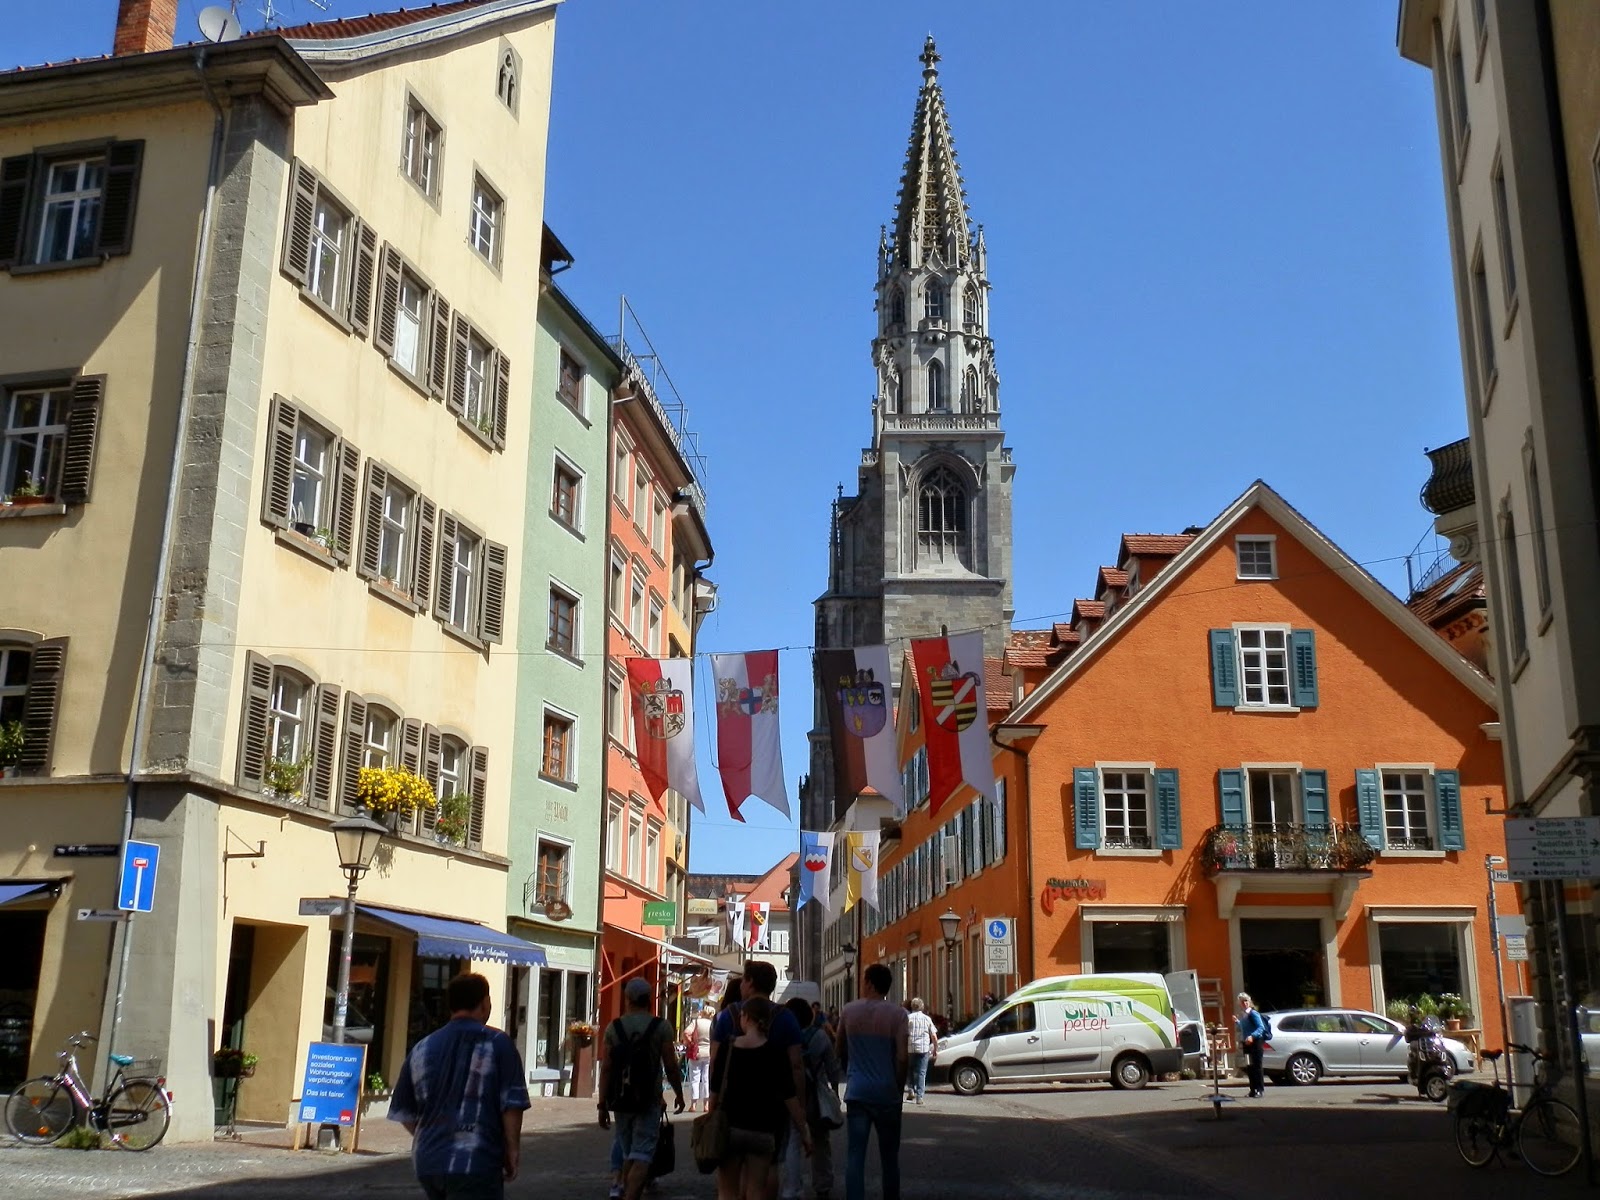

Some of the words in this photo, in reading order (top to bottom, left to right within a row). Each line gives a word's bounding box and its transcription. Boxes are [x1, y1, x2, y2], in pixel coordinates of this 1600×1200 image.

[1063, 1008, 1111, 1041] peter
[311, 1053, 344, 1062] Investoren
[309, 1068, 353, 1078] Wohnungsbau
